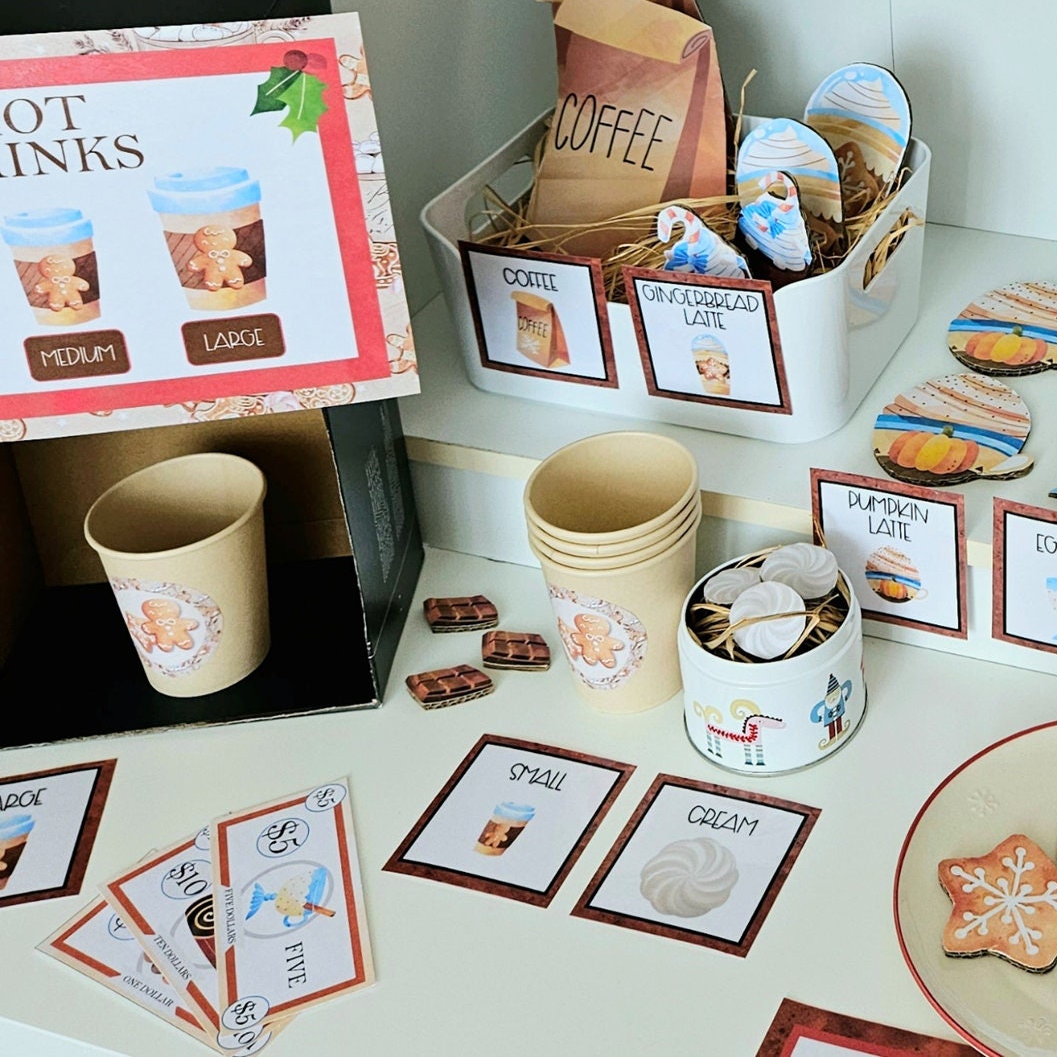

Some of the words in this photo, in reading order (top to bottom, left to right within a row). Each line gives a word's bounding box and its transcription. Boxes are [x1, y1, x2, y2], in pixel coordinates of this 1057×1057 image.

[0, 95, 86, 135] OT
[554, 92, 673, 172] COFFEE
[0, 134, 145, 178] INKS
[502, 267, 559, 292] COFFEE
[642, 284, 759, 313] GINGERBREAD
[517, 315, 549, 339] COFFEE
[683, 309, 727, 330] LATTE
[203, 329, 265, 353] LARGE
[40, 345, 117, 368] MEDIUM
[847, 489, 929, 525] PUMPKIN
[868, 513, 912, 543] LATTE
[509, 762, 567, 792] SMALL
[0, 787, 48, 812] RGE
[315, 787, 337, 808] $5
[687, 804, 760, 837] CREAM
[261, 819, 303, 855] $5
[166, 860, 208, 896] $10
[224, 888, 234, 909] FIVE
[225, 907, 237, 944] DOLLARS
[284, 941, 307, 989] FIVE
[232, 1000, 257, 1026] $5
